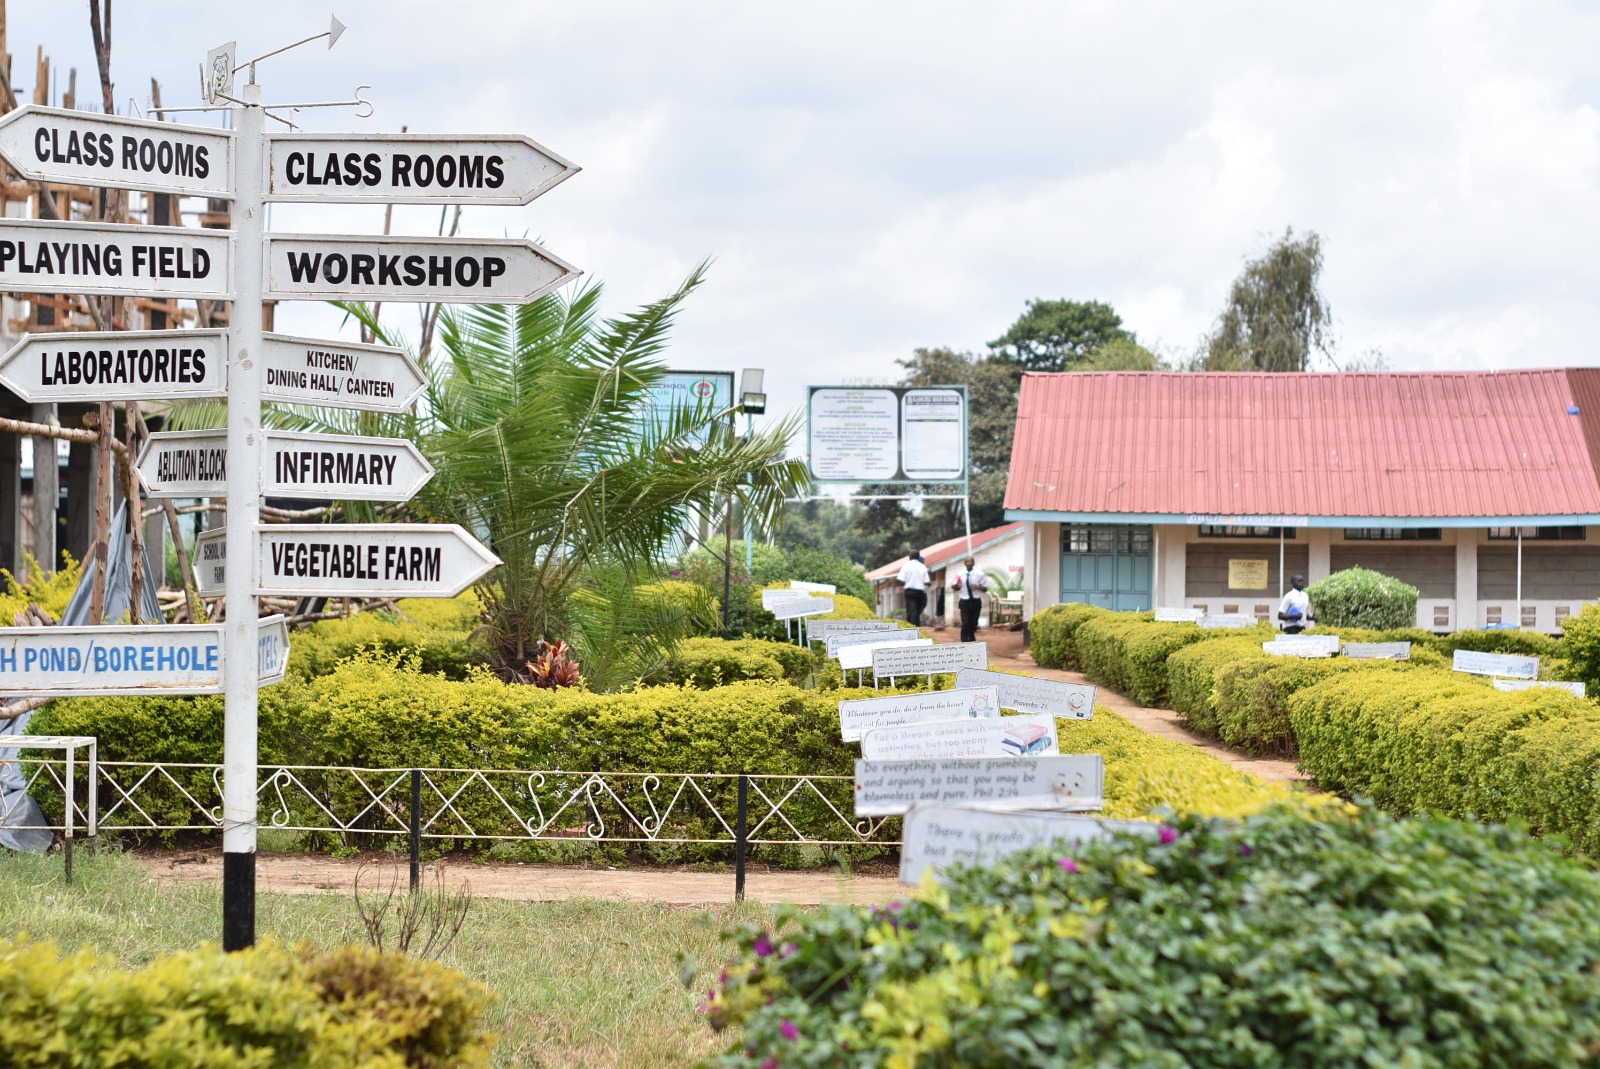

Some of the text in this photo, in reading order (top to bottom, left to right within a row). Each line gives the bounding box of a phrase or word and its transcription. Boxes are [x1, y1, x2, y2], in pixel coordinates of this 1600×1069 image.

[34, 126, 210, 179] CLASS ROOMS
[285, 151, 505, 189] CLASS ROOMS
[0, 240, 211, 279] PLAYING FIELD
[287, 251, 507, 288] WORKSHOP
[41, 348, 206, 385] LABORATORIES
[306, 350, 359, 375] KITCHEN/
[267, 368, 395, 398] DINING HALL/ CANTEEN
[157, 447, 227, 484] ABLUTION BLOCK
[275, 450, 397, 487] INFIRMARY
[271, 541, 379, 579] VEGETABLE
[385, 545, 442, 582] FARM
[24, 639, 218, 674] POND/BOREHOLE
[847, 709, 878, 719] Whatever
[879, 709, 893, 717] you
[919, 702, 936, 713] from
[936, 702, 946, 710] the
[1012, 698, 1039, 709] Proverbs
[874, 731, 890, 743] For
[901, 730, 931, 741] dream
[934, 728, 965, 737] comes
[966, 723, 986, 734] with
[988, 720, 1014, 732] much
[925, 738, 942, 750] but
[944, 738, 960, 747] too
[962, 737, 988, 746] many
[864, 758, 1038, 775] Do everything without grumbling
[864, 772, 1036, 790] and arguing so that you may be
[864, 791, 915, 803] blameless
[919, 788, 940, 801] and
[973, 787, 993, 798] Phil
[926, 822, 963, 839] There
[923, 843, 947, 857] but
